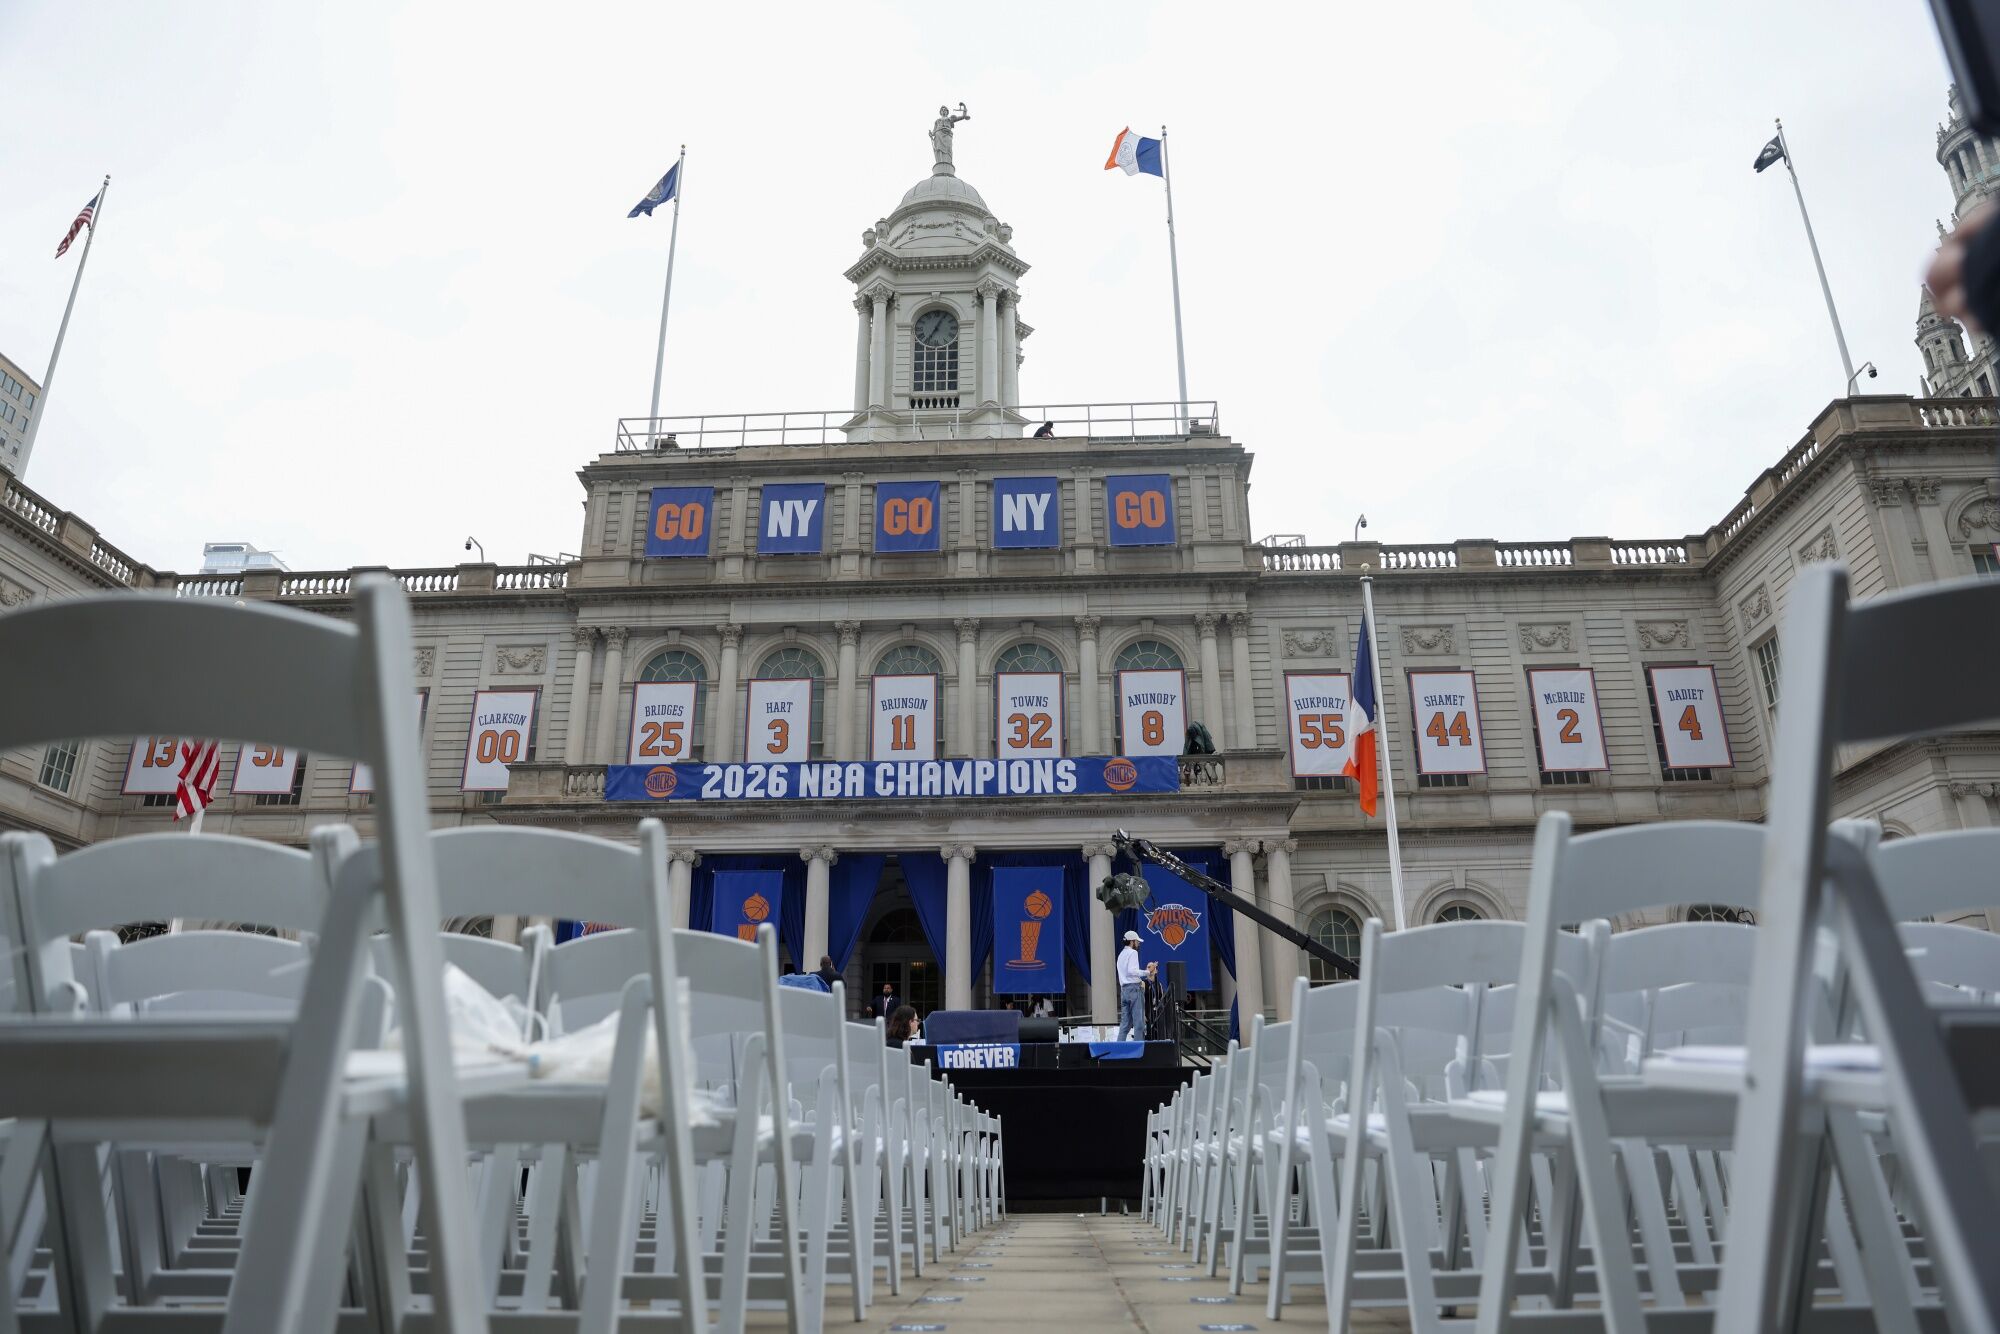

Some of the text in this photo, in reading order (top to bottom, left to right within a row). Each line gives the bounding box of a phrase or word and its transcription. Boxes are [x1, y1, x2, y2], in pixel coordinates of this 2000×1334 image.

[655, 502, 705, 541] GO
[767, 499, 818, 538] NY
[883, 497, 933, 536] GO
[1002, 493, 1051, 531] NY
[1115, 490, 1166, 529] GO
[644, 704, 685, 717] BRIDGES
[765, 701, 794, 714] HART
[880, 697, 929, 712] BRUNSON
[1010, 695, 1049, 708] TOWNS
[1127, 692, 1177, 708] ANUNOBY
[1293, 696, 1347, 711] HUKPORTI
[1423, 694, 1466, 707] SHAMET
[1667, 688, 1705, 702] DADIET
[478, 713, 528, 727] CLARKSON
[766, 718, 790, 755] 3
[891, 714, 916, 751] 11
[1007, 712, 1053, 749] 32
[1141, 710, 1165, 746] 8
[1298, 713, 1346, 750] 55
[1426, 711, 1472, 747] 44
[1556, 708, 1583, 744] 2
[1678, 704, 1704, 741] 4
[142, 735, 178, 768] 13
[476, 729, 521, 764] 00
[639, 721, 685, 757] 25
[646, 772, 676, 792] KNICKS
[701, 759, 1077, 798] 2026 NBA CHAMPIONS
[1105, 764, 1136, 784] KNICKS
[1149, 909, 1198, 929] KNICKS
[943, 1046, 1015, 1069] FOREVER
